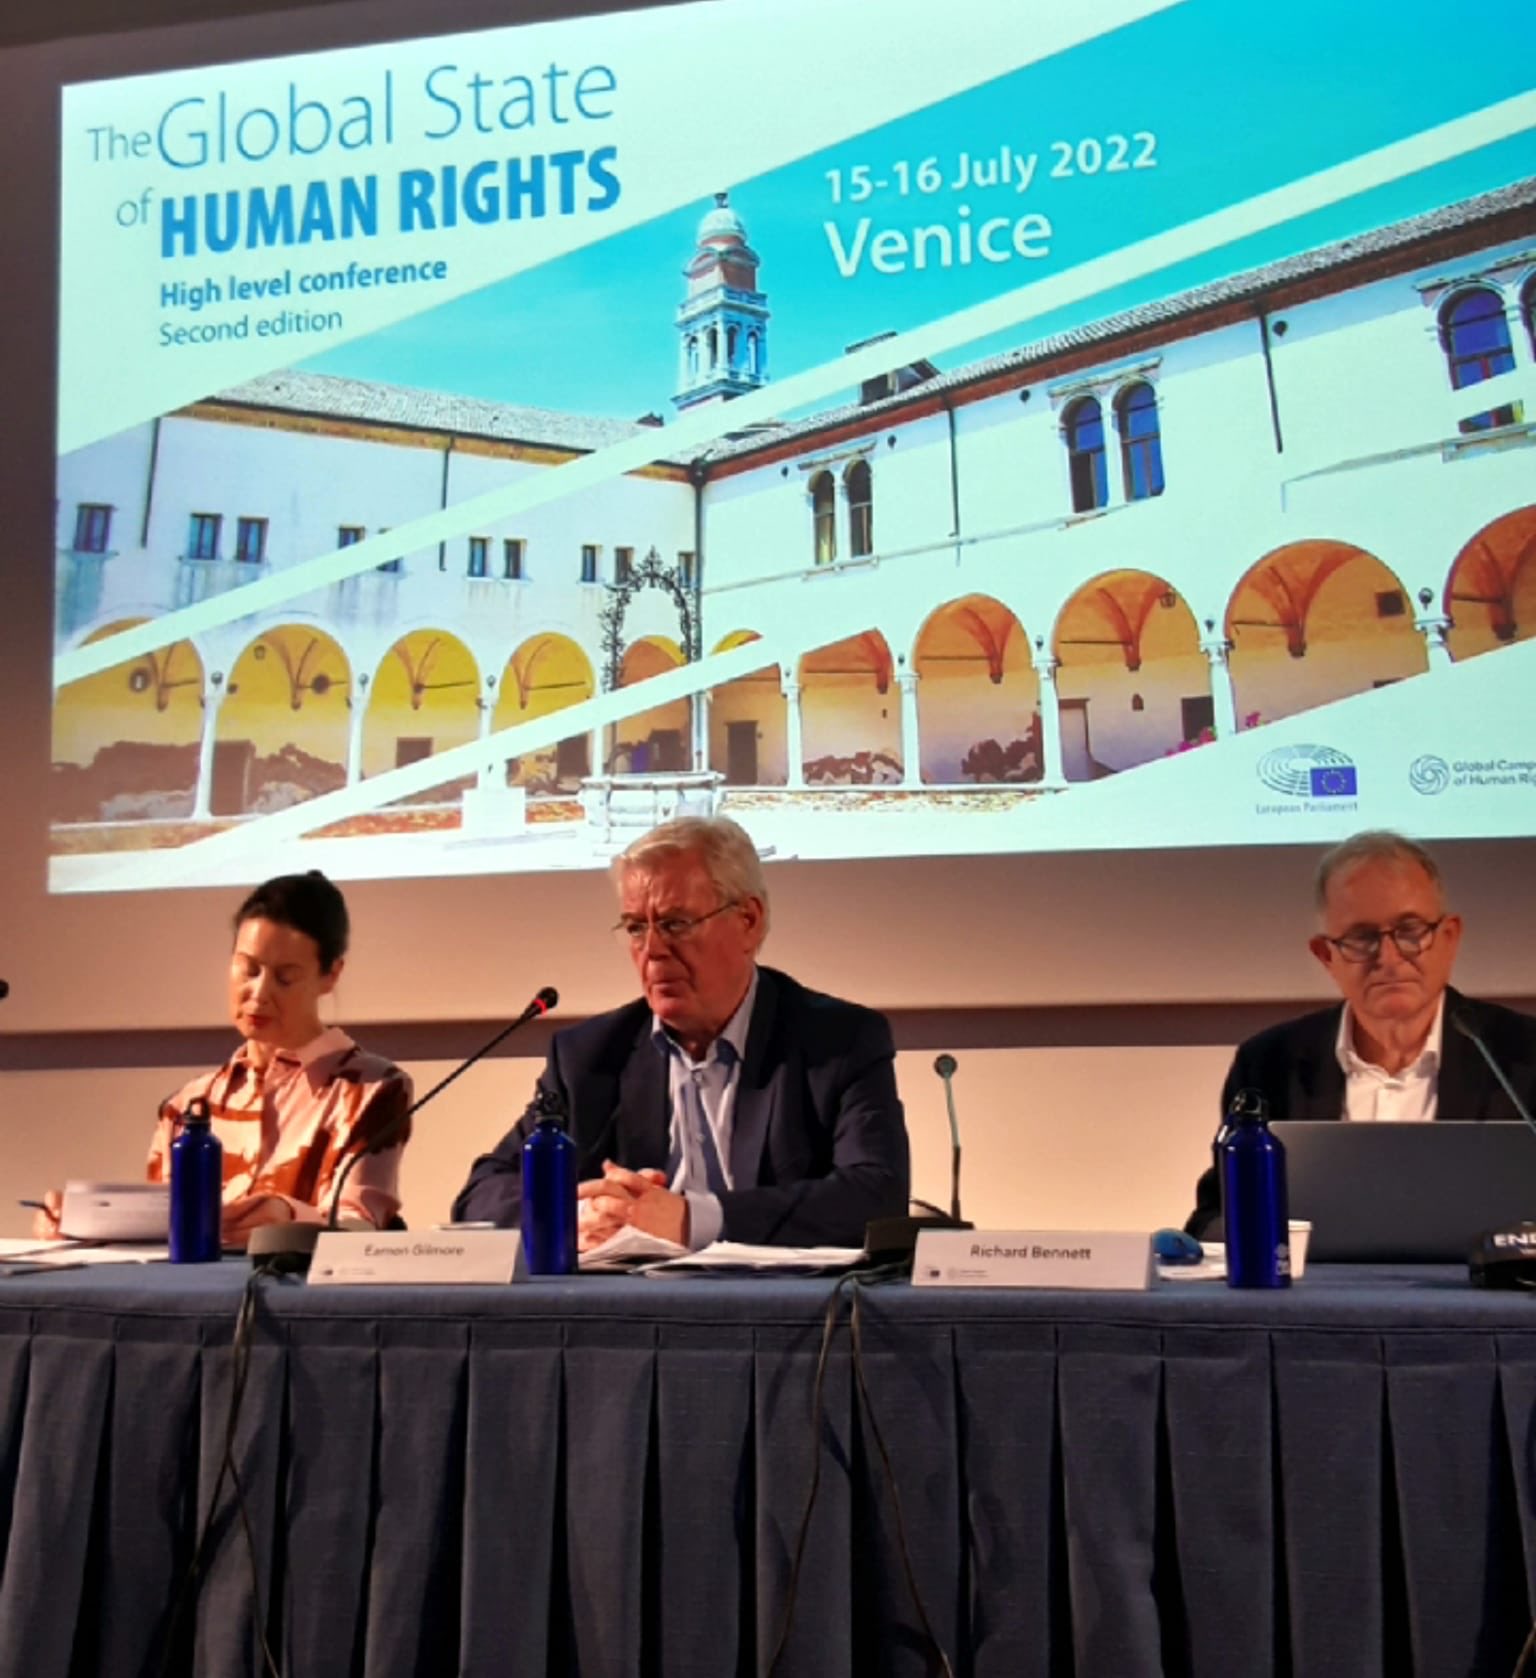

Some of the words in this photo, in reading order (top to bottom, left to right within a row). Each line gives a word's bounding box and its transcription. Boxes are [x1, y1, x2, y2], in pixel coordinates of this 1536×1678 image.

[87, 126, 152, 163] The
[157, 70, 393, 168] Global
[424, 62, 617, 139] State
[824, 157, 943, 204] 15-16
[951, 145, 1038, 194] July
[1049, 131, 1158, 178] 2022
[116, 187, 153, 228] of
[160, 174, 378, 259] HUMAN
[399, 146, 622, 233] RIGHTS
[823, 205, 1053, 278] Venice
[159, 278, 222, 312] High
[229, 271, 292, 301] level
[298, 259, 448, 293] conference
[158, 315, 250, 347] Second
[256, 307, 344, 337] edition
[1469, 773, 1516, 786] Human
[970, 1244, 1028, 1259] Richard
[1032, 1245, 1092, 1260] Bennett
